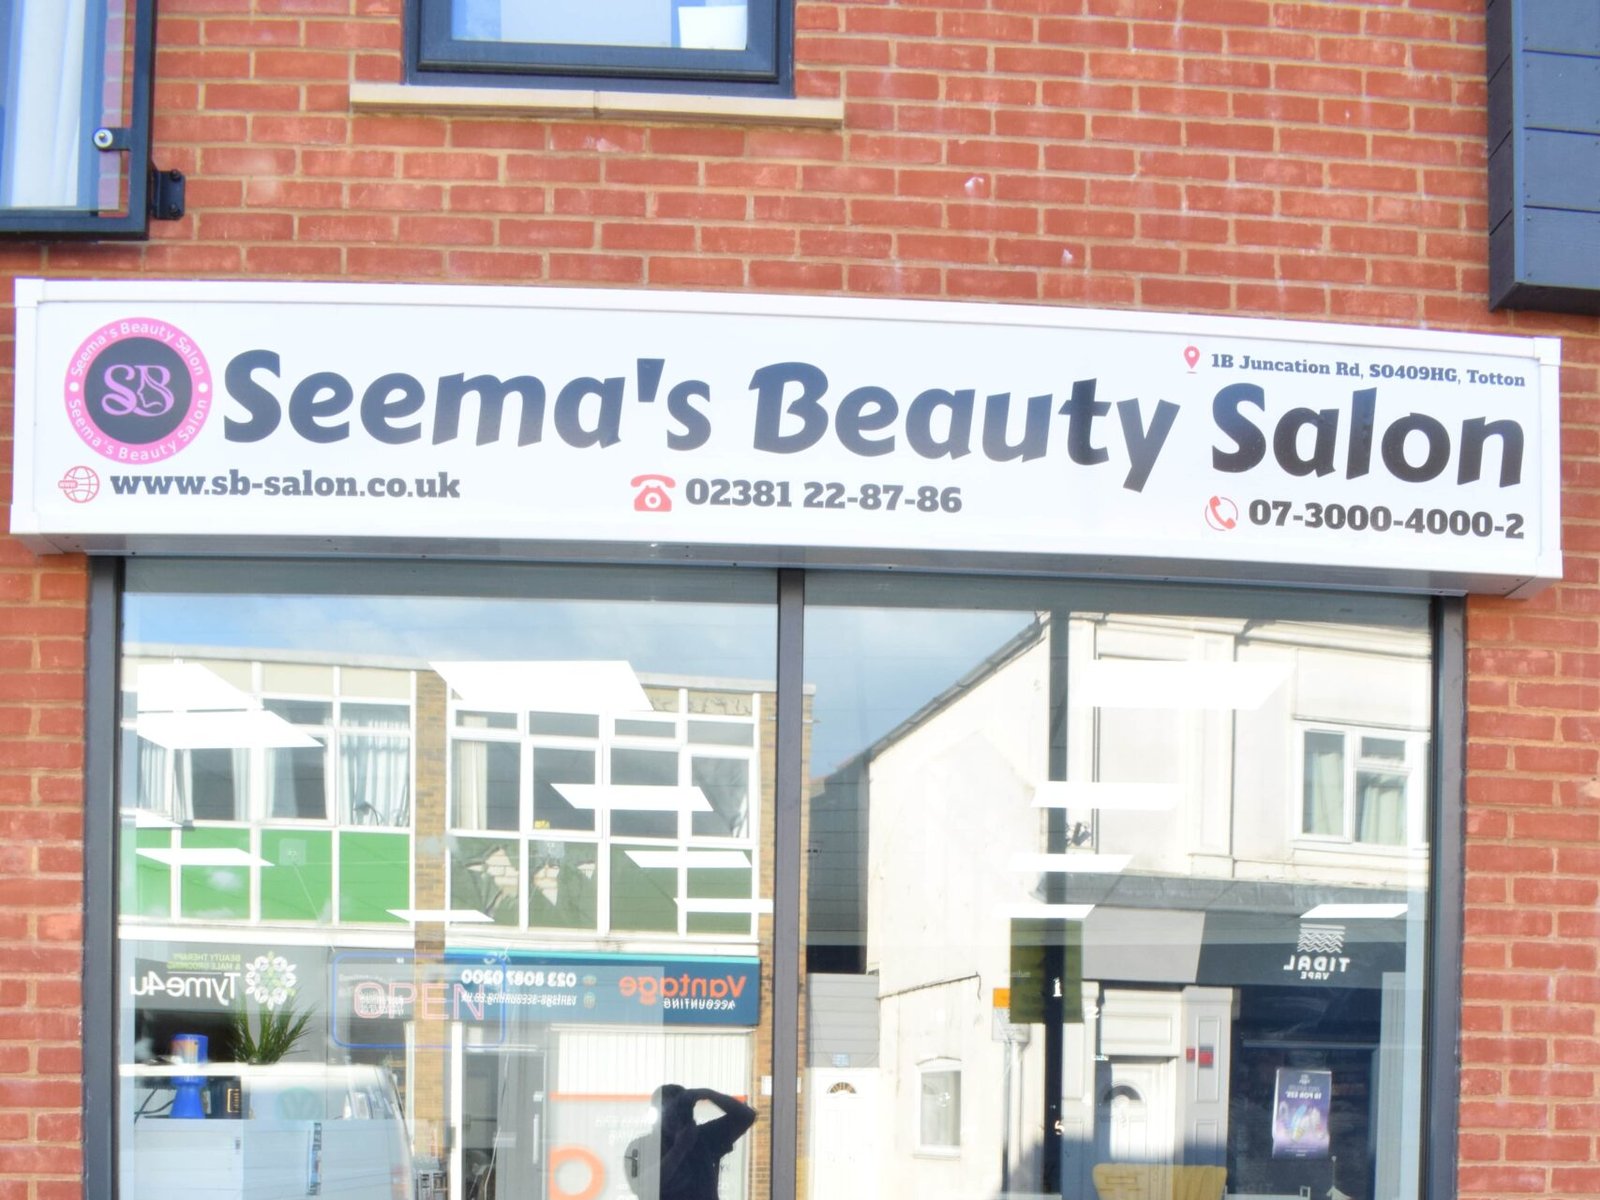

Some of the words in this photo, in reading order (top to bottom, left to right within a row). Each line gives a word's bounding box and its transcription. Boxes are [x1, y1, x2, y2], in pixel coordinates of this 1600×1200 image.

[70, 327, 118, 377] Seema's
[120, 321, 174, 341] Beauty
[175, 335, 204, 377] Salon
[1211, 353, 1234, 369] 1B
[1239, 355, 1331, 375] Juncation
[1335, 361, 1364, 379] Rd,
[1467, 369, 1525, 387] Totton
[69, 398, 115, 455] Seema's
[118, 440, 177, 461] Beauty
[177, 398, 208, 442] Salon
[223, 349, 712, 451] Seema's
[747, 361, 1181, 493] Beauty
[1211, 383, 1525, 488] Salon
[110, 469, 461, 498] www.sb-salon.co.uk
[685, 478, 792, 508] 02381
[803, 481, 963, 513] 22-87-86
[1248, 499, 1524, 540] 07-3000-4000-2
[353, 981, 485, 1020] OPEN
